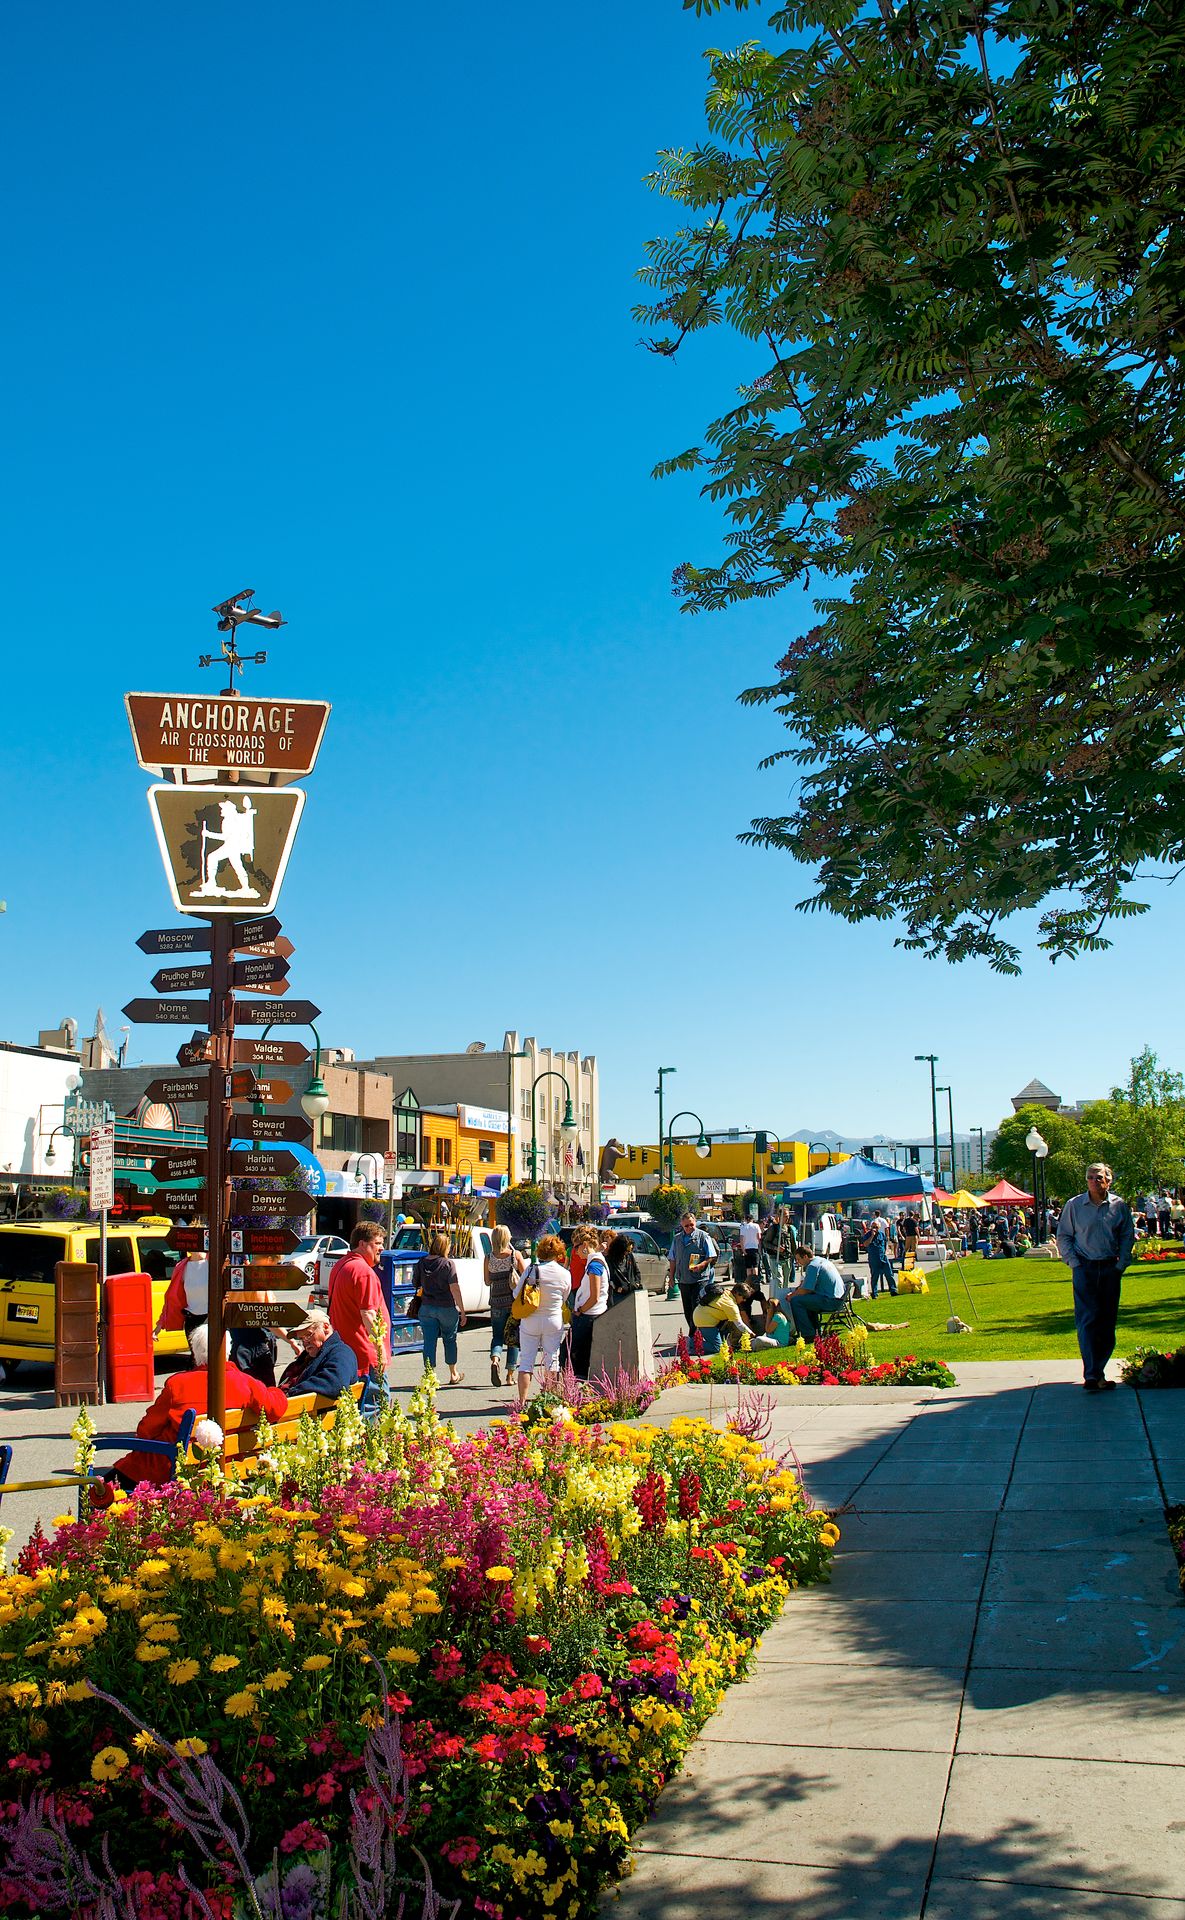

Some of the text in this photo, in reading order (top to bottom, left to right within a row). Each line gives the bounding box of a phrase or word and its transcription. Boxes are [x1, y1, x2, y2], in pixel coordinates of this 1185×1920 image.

[159, 702, 296, 734] ANCHORAGE
[160, 731, 294, 751] AIR CROSSROADS OF
[188, 748, 265, 765] THE WORLD
[244, 925, 264, 934] Homer
[158, 934, 194, 942] Moscow
[245, 962, 274, 973] Honolulu
[161, 970, 206, 981] Prudhoe Bay
[158, 1004, 187, 1012] Nome
[265, 1002, 283, 1010] San
[251, 1010, 296, 1018] Francisco
[254, 1044, 283, 1054] Valdez
[163, 1083, 198, 1092] Fairbanks
[253, 1082, 270, 1091] iami
[252, 1120, 285, 1129] Seward
[247, 1154, 274, 1163] Harbin
[168, 1158, 197, 1169] Brussels
[166, 1193, 197, 1201] Frankfurt
[252, 1195, 286, 1204] Denver
[92, 1198, 111, 1206] CLEANING
[238, 1304, 285, 1312] Vancouver,
